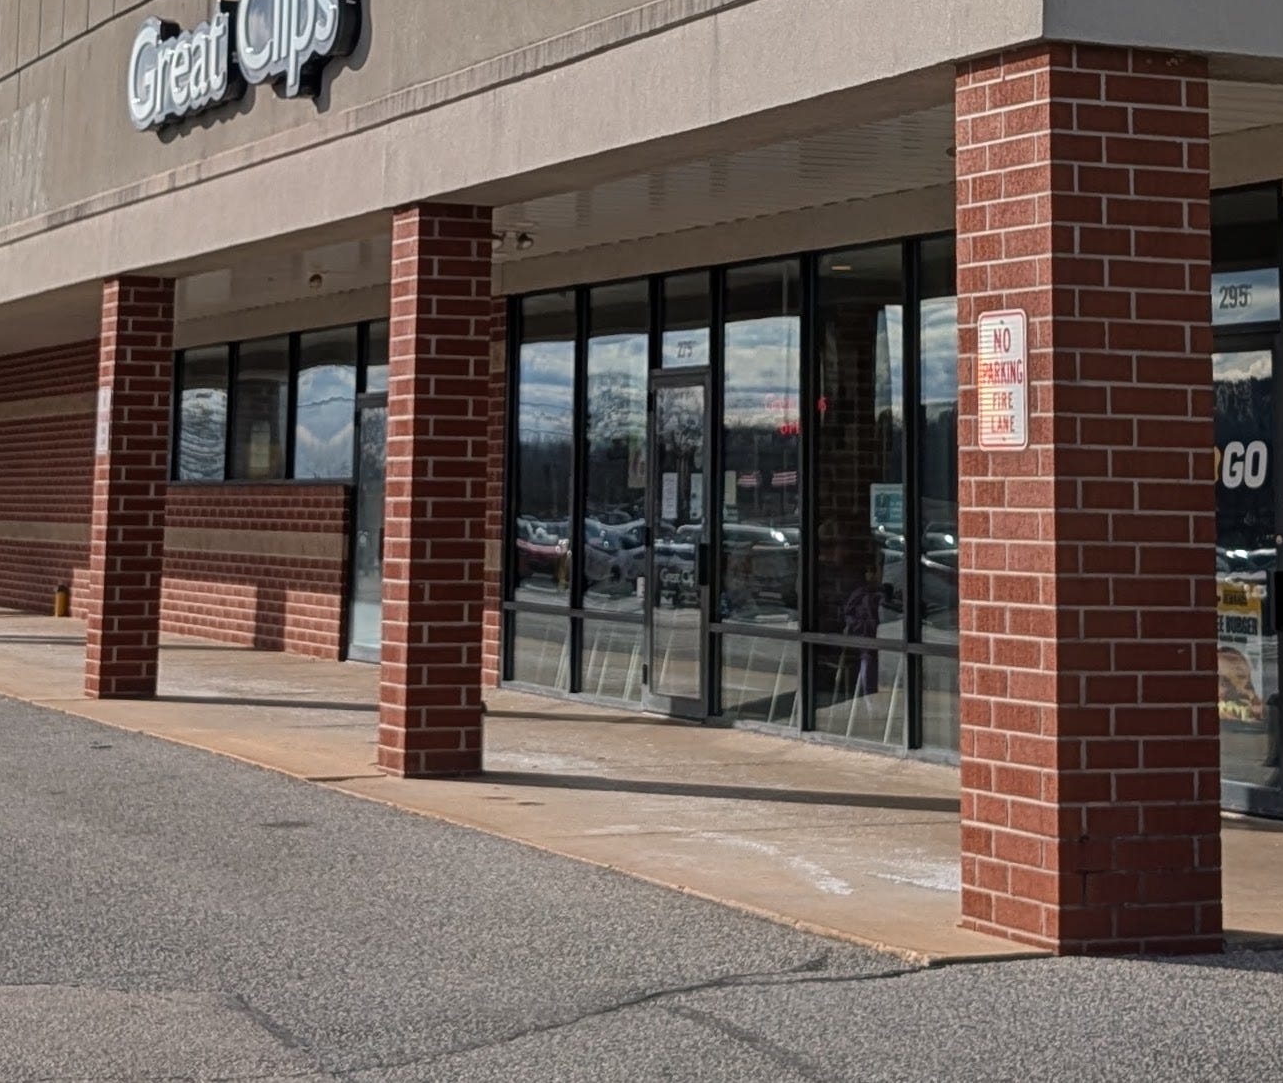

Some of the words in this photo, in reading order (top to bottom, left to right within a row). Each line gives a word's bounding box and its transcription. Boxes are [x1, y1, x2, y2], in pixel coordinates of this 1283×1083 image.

[129, 12, 229, 120] Great
[1219, 283, 1249, 309] 295
[993, 327, 1012, 354] NO
[981, 359, 1023, 385] PARKING
[992, 391, 1014, 410] FIRE
[991, 415, 1015, 434] LANE
[1222, 440, 1268, 489] GO
